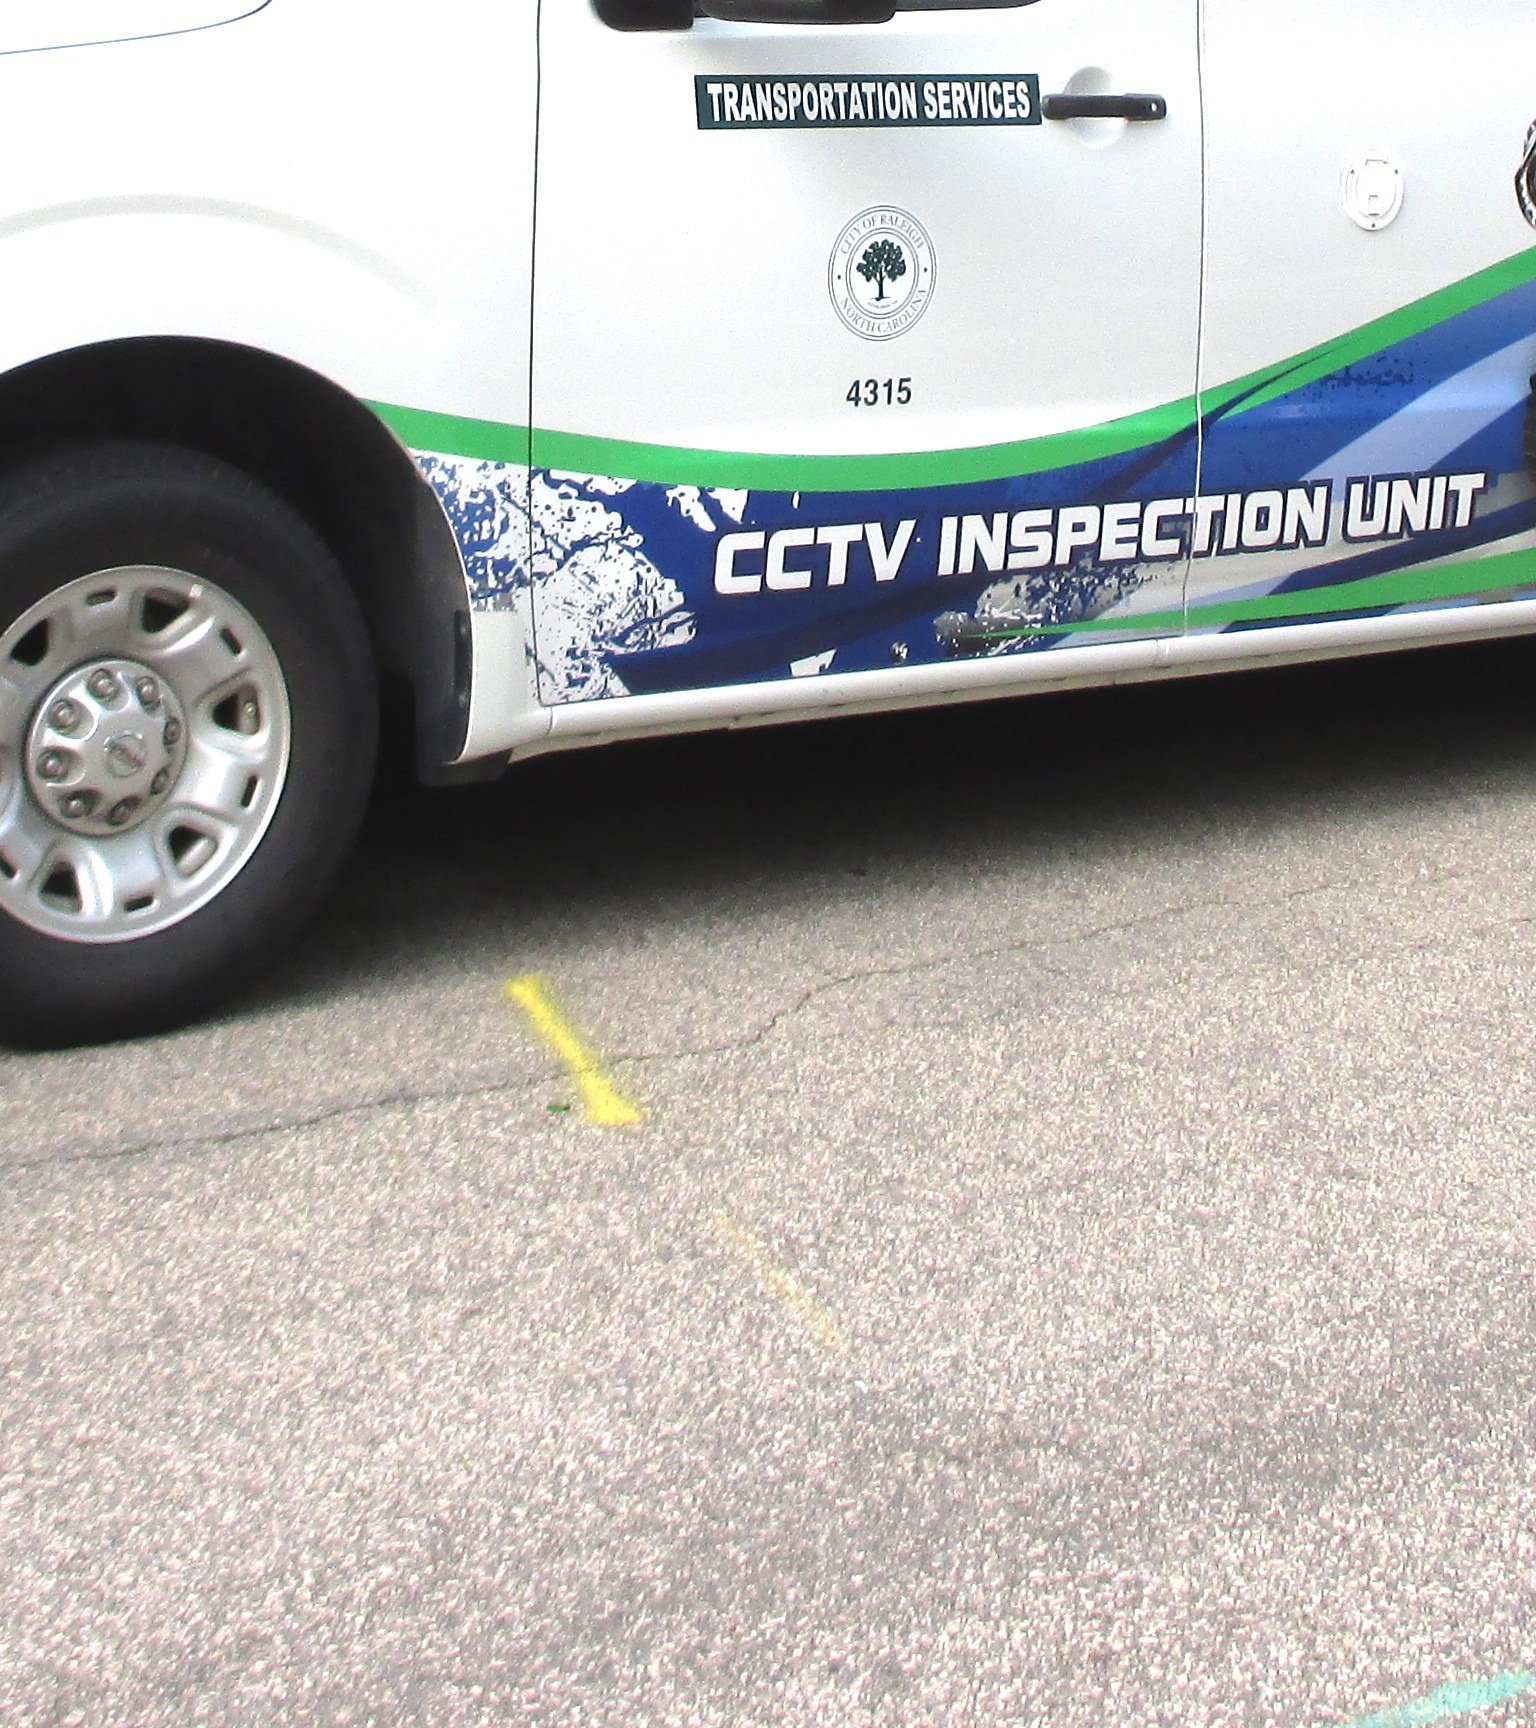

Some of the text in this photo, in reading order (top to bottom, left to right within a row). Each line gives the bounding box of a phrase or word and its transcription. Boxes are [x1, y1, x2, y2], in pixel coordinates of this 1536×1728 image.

[707, 80, 1032, 122] TRANSPORTATION SERVICES
[840, 214, 925, 255] CITY OF RALEIGH
[841, 289, 927, 333] NORTH CAROLINA
[846, 377, 913, 408] 4315
[715, 472, 1487, 595] CCTV INSPECTION UNIT
